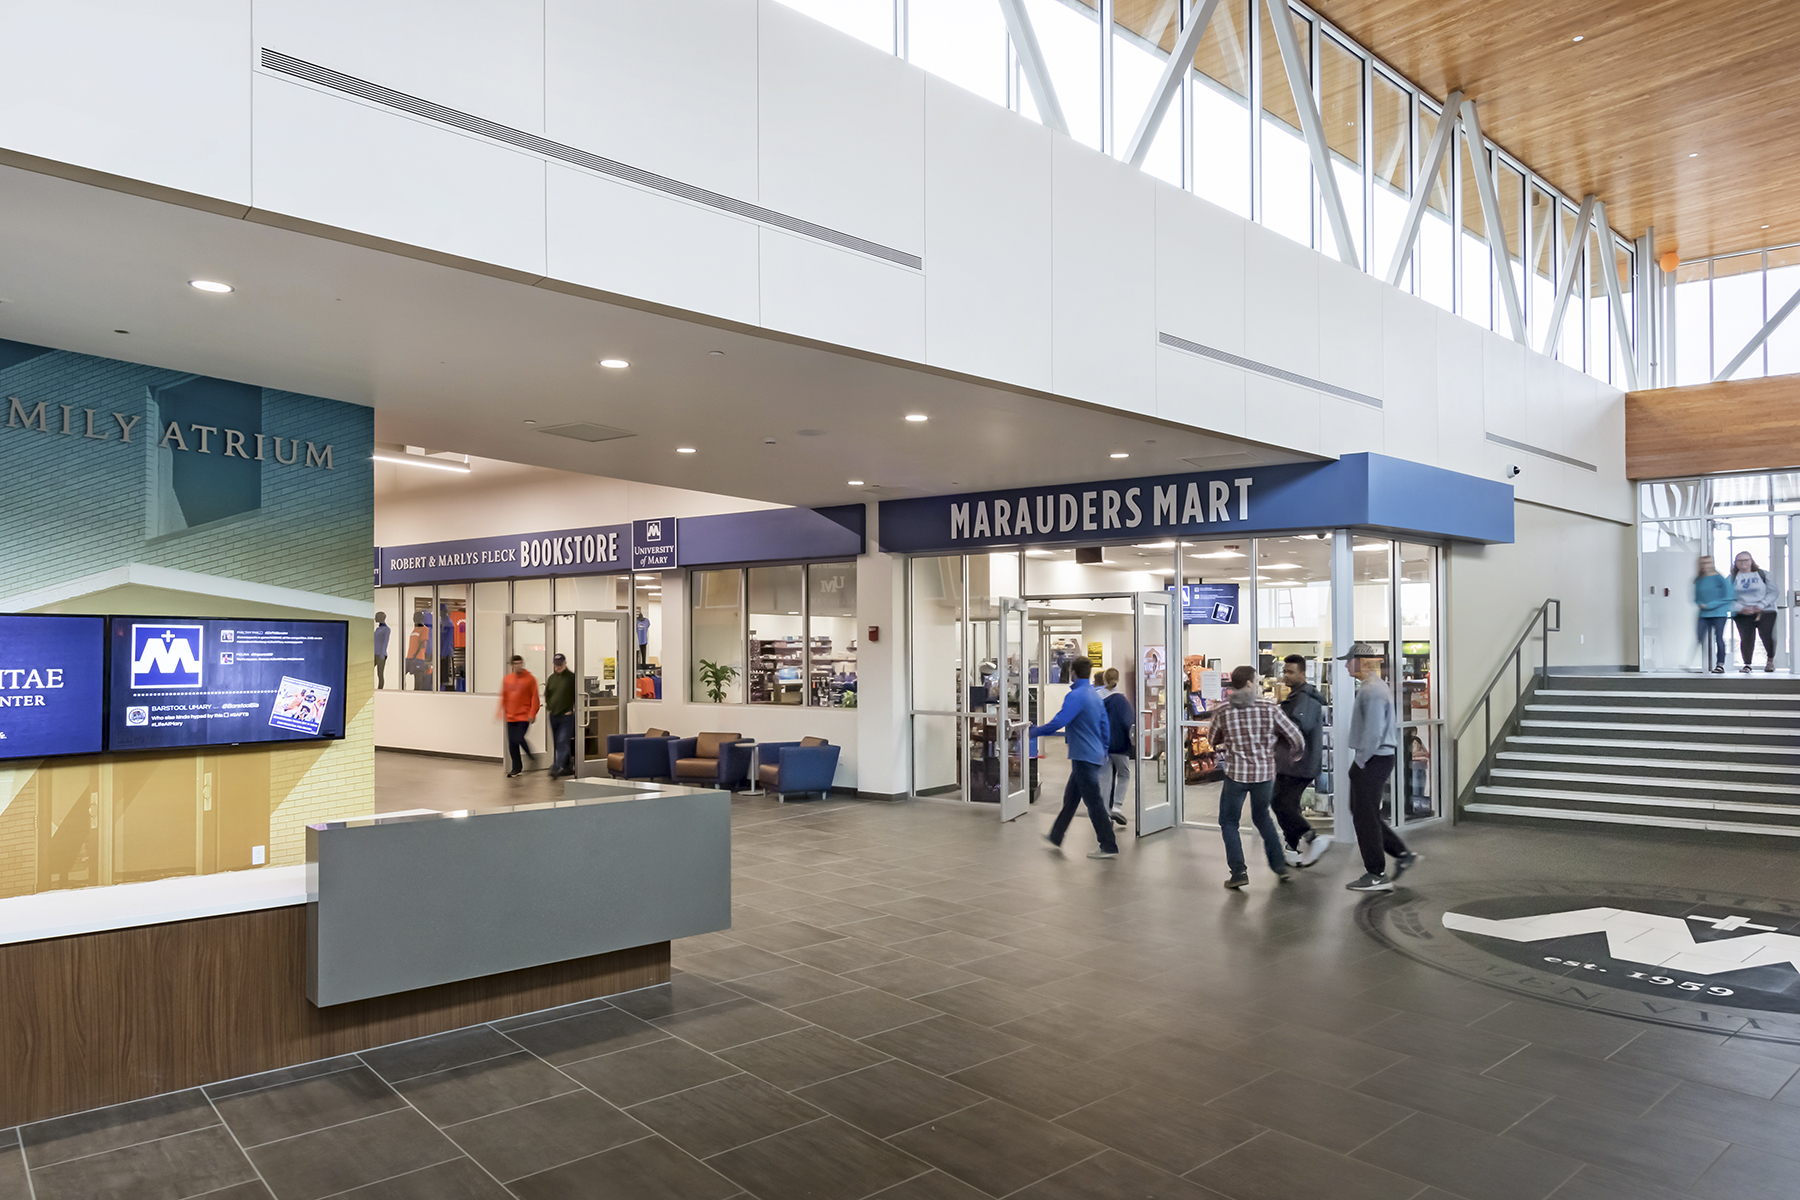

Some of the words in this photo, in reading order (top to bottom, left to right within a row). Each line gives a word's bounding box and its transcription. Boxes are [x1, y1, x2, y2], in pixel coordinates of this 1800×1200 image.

[5, 396, 142, 443] MILY
[158, 420, 335, 470] ATRIUM
[950, 486, 1143, 540] MARAUDERS
[1153, 477, 1253, 526] MART
[390, 556, 427, 571] ROBERT
[428, 555, 436, 568] &
[438, 551, 479, 568] MARLYS
[481, 548, 517, 564] FLECK
[520, 532, 619, 568] BOOKSTORE
[634, 545, 675, 556] UNIVERSITY
[640, 556, 647, 566] of
[647, 555, 668, 565] MARY
[1542, 954, 1609, 974] est.
[1625, 969, 1736, 997] 1959
